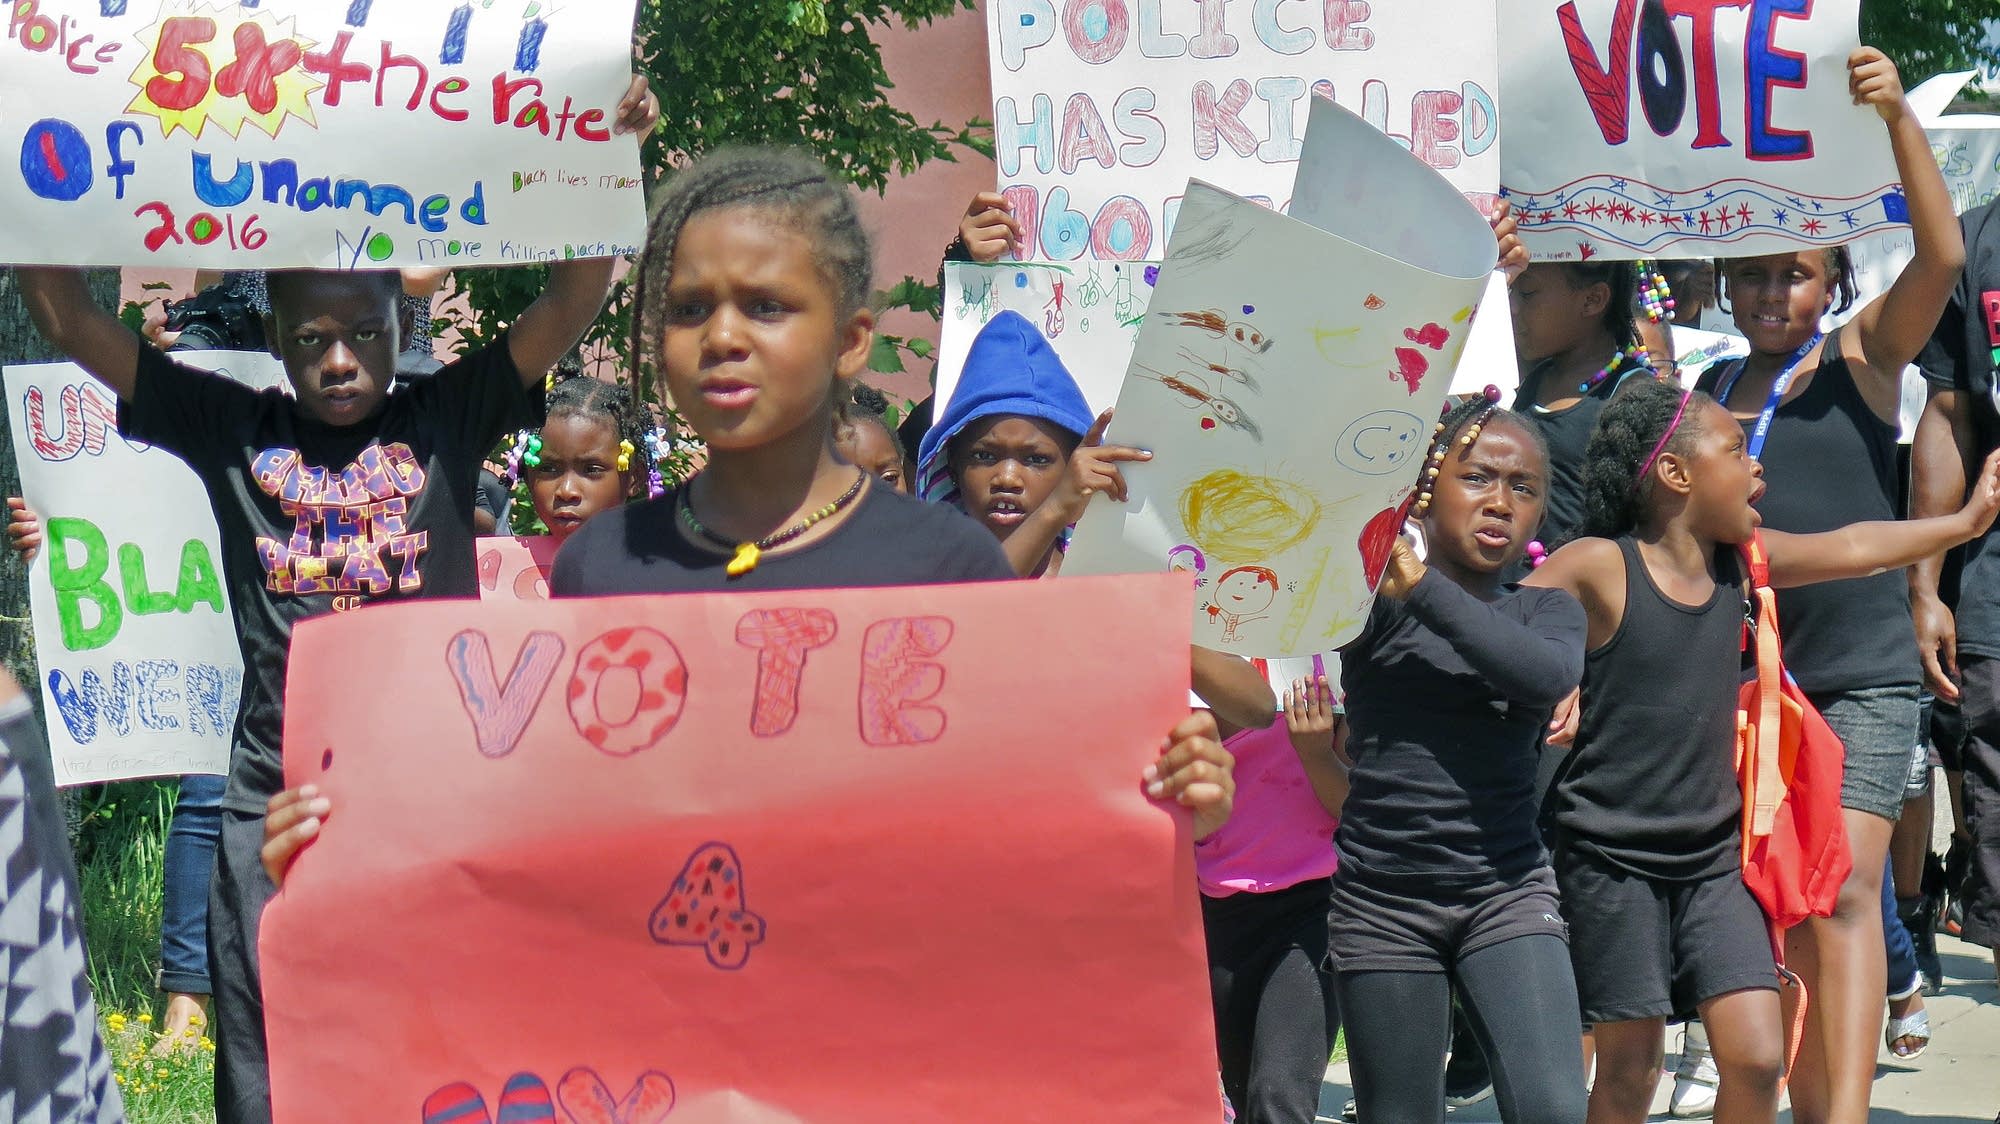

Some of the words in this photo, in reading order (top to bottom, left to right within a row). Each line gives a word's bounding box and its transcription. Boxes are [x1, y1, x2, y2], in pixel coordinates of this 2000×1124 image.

[997, 0, 1376, 72] POLICE
[303, 30, 472, 122] the
[491, 71, 612, 143] rate
[1556, 0, 1815, 162] VOTE
[996, 87, 1166, 177] HAS
[1191, 76, 1498, 170] KILED
[135, 201, 268, 254] 2016
[250, 442, 427, 506] BRING
[255, 530, 428, 595] HEAT
[279, 496, 407, 558] THE
[445, 607, 955, 759] VOTE
[648, 841, 766, 970] 4
